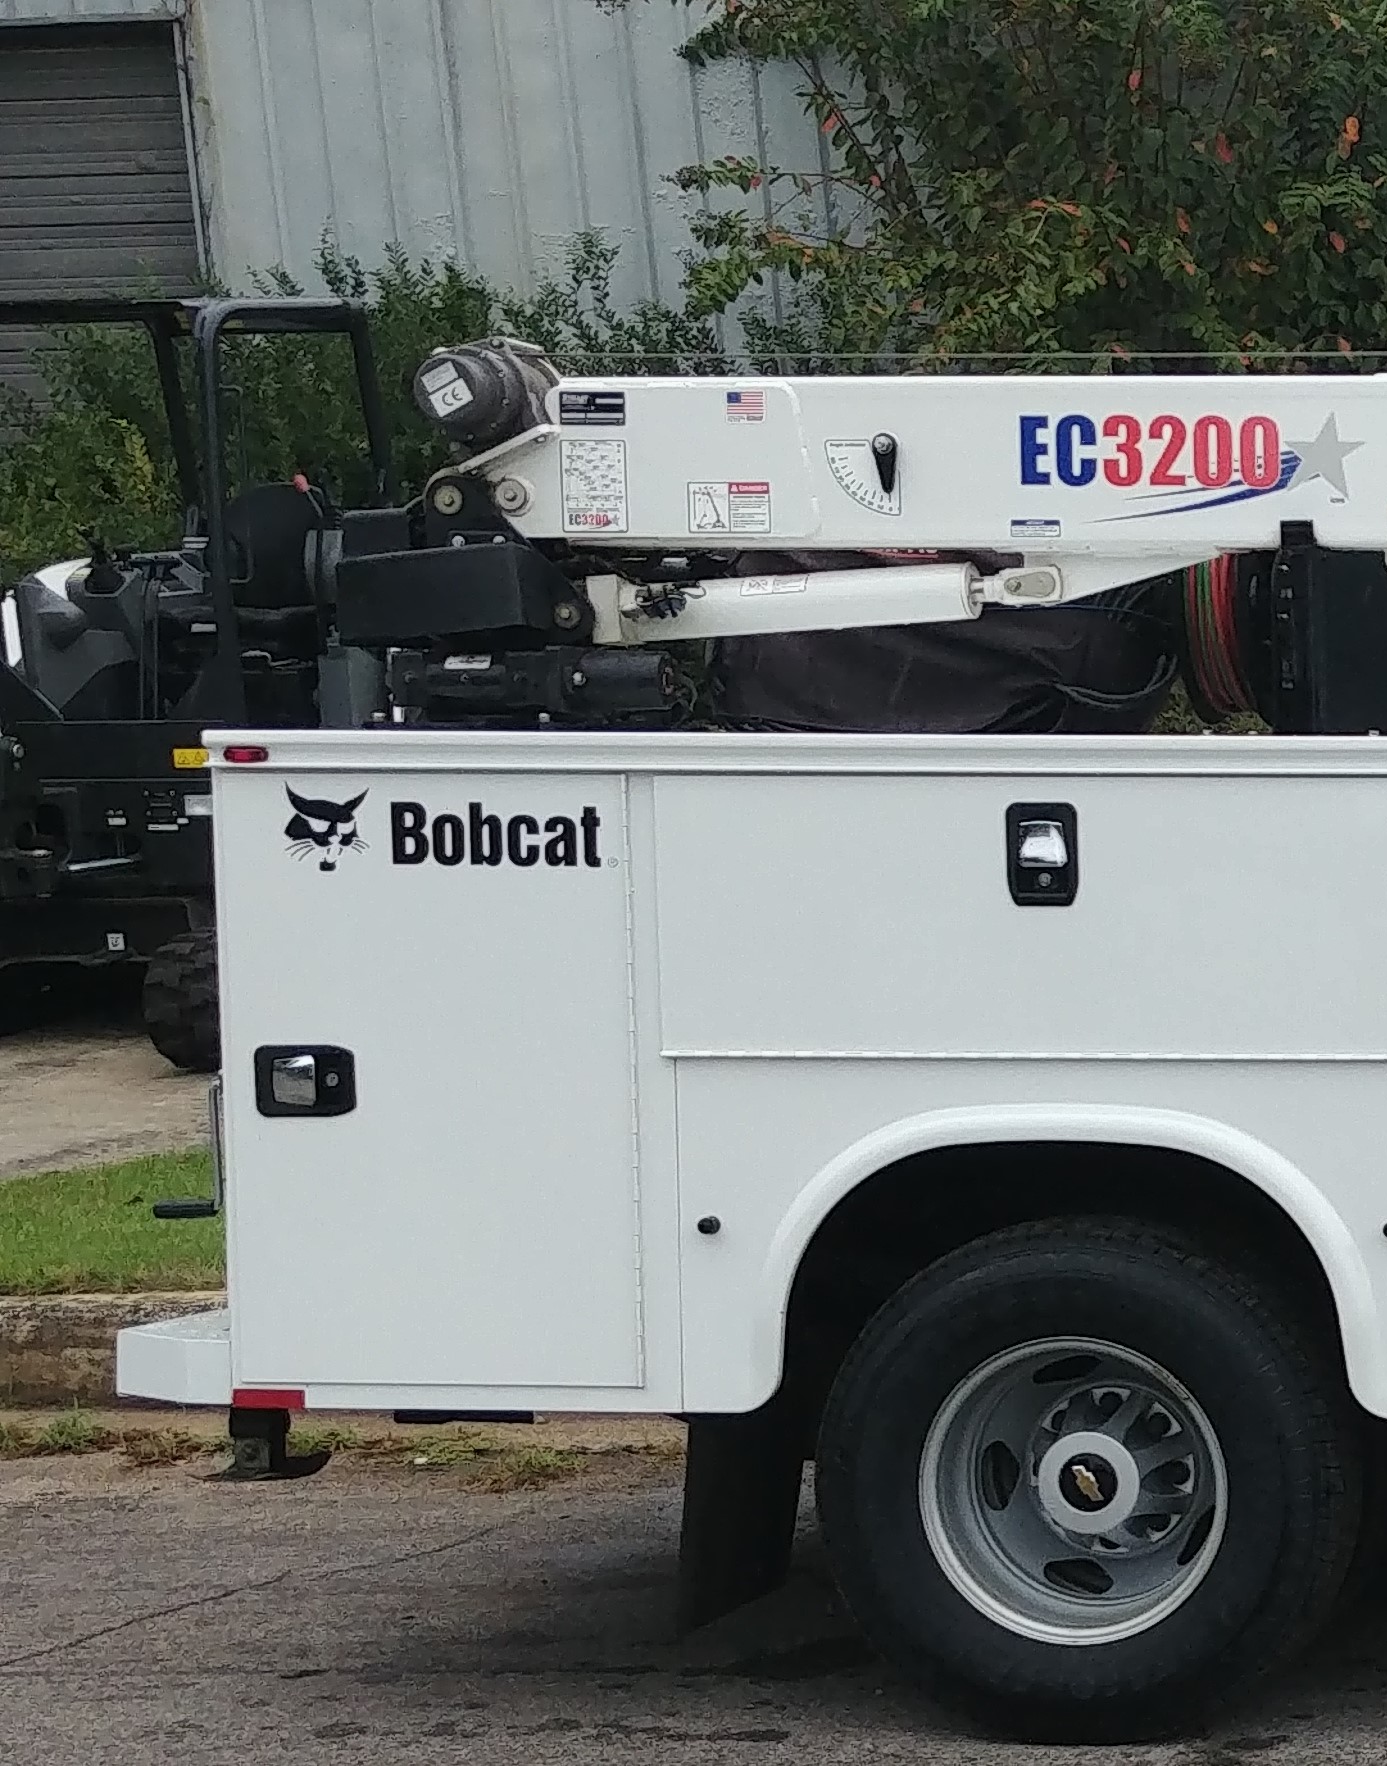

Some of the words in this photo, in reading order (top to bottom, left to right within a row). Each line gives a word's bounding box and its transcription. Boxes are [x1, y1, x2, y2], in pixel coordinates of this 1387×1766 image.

[1019, 414, 1281, 488] EC3200
[568, 513, 610, 526] EC3200
[390, 801, 602, 868] Bobcat
